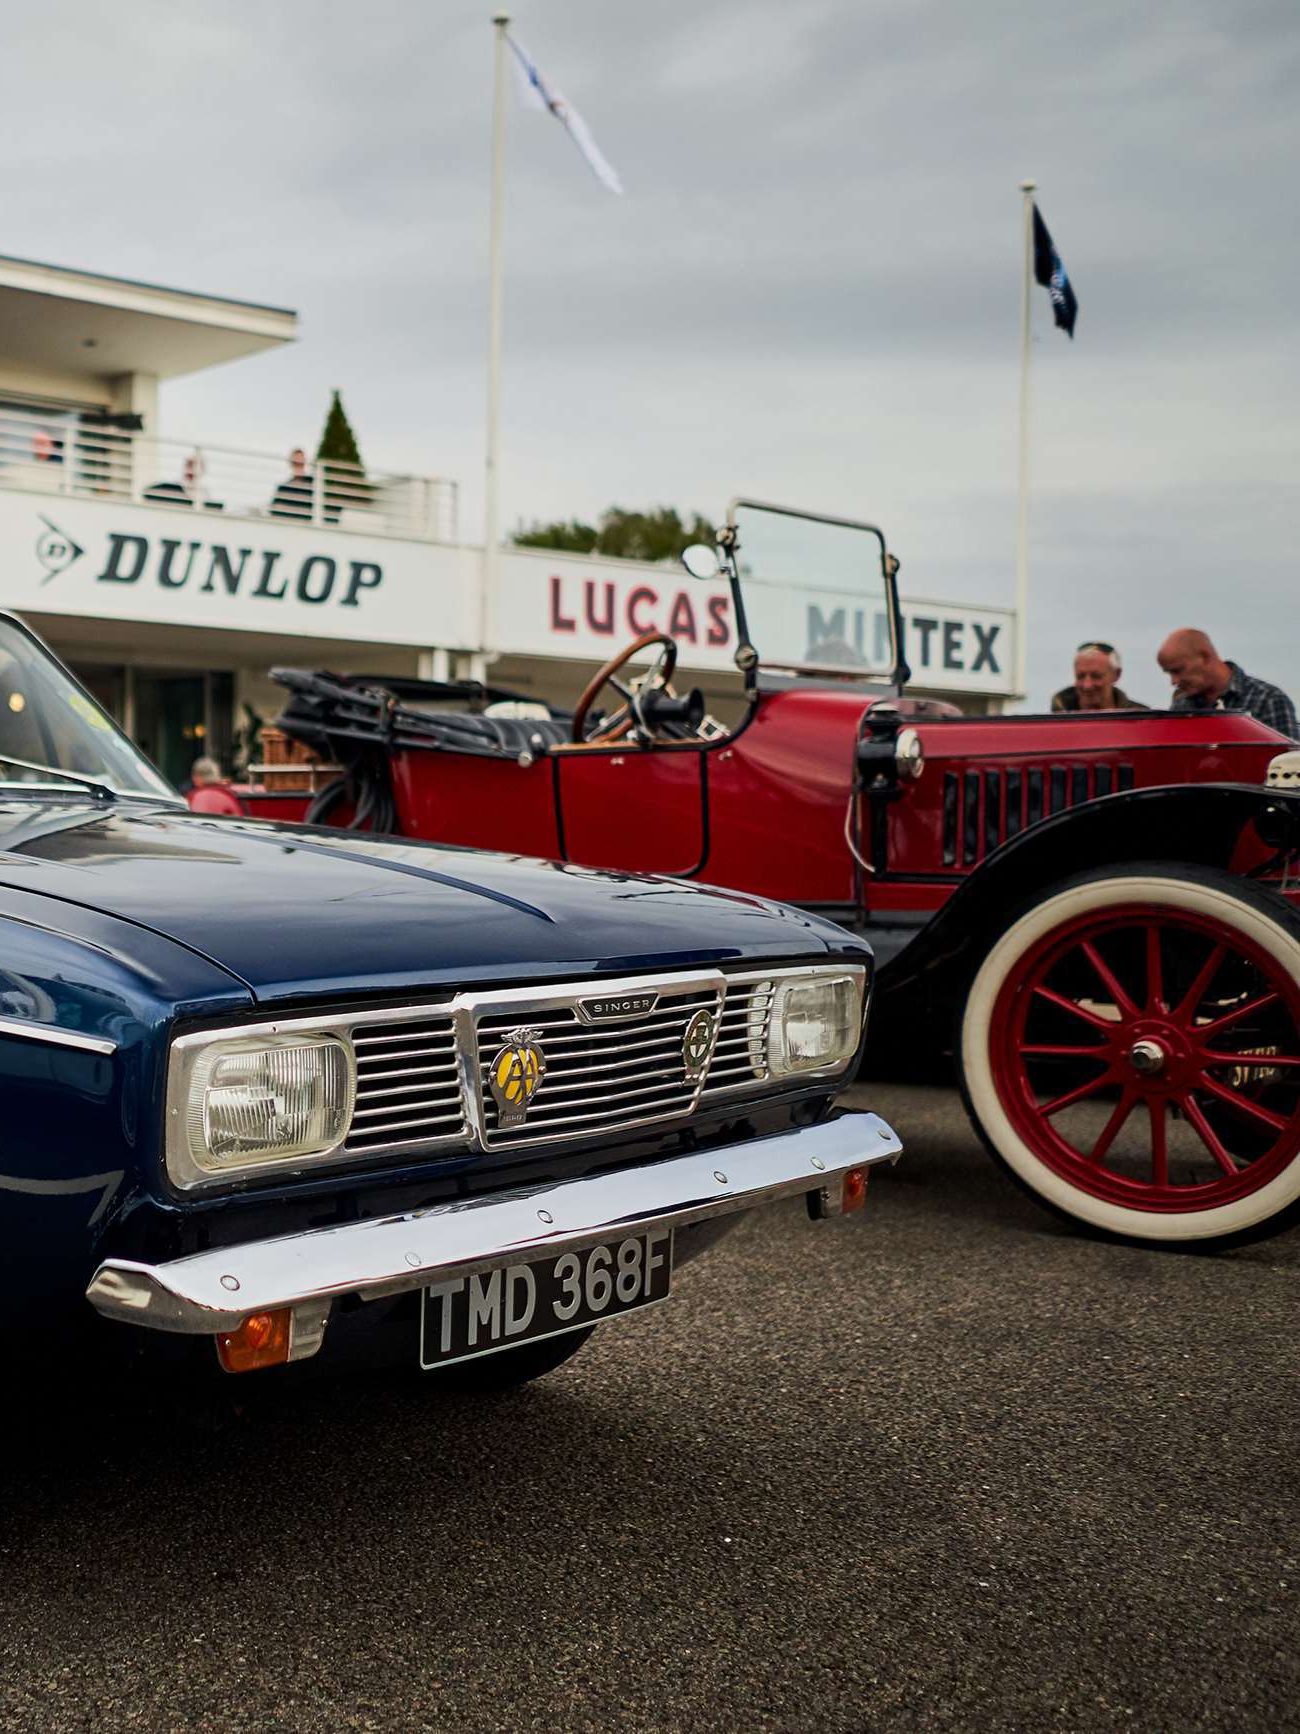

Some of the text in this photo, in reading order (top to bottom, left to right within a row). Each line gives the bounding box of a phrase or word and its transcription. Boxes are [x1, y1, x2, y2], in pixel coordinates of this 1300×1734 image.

[97, 533, 383, 606] DUNLOP
[550, 577, 731, 645] LUCAS
[593, 999, 651, 1013] SINGER
[429, 1231, 669, 1353] TMD 368F
